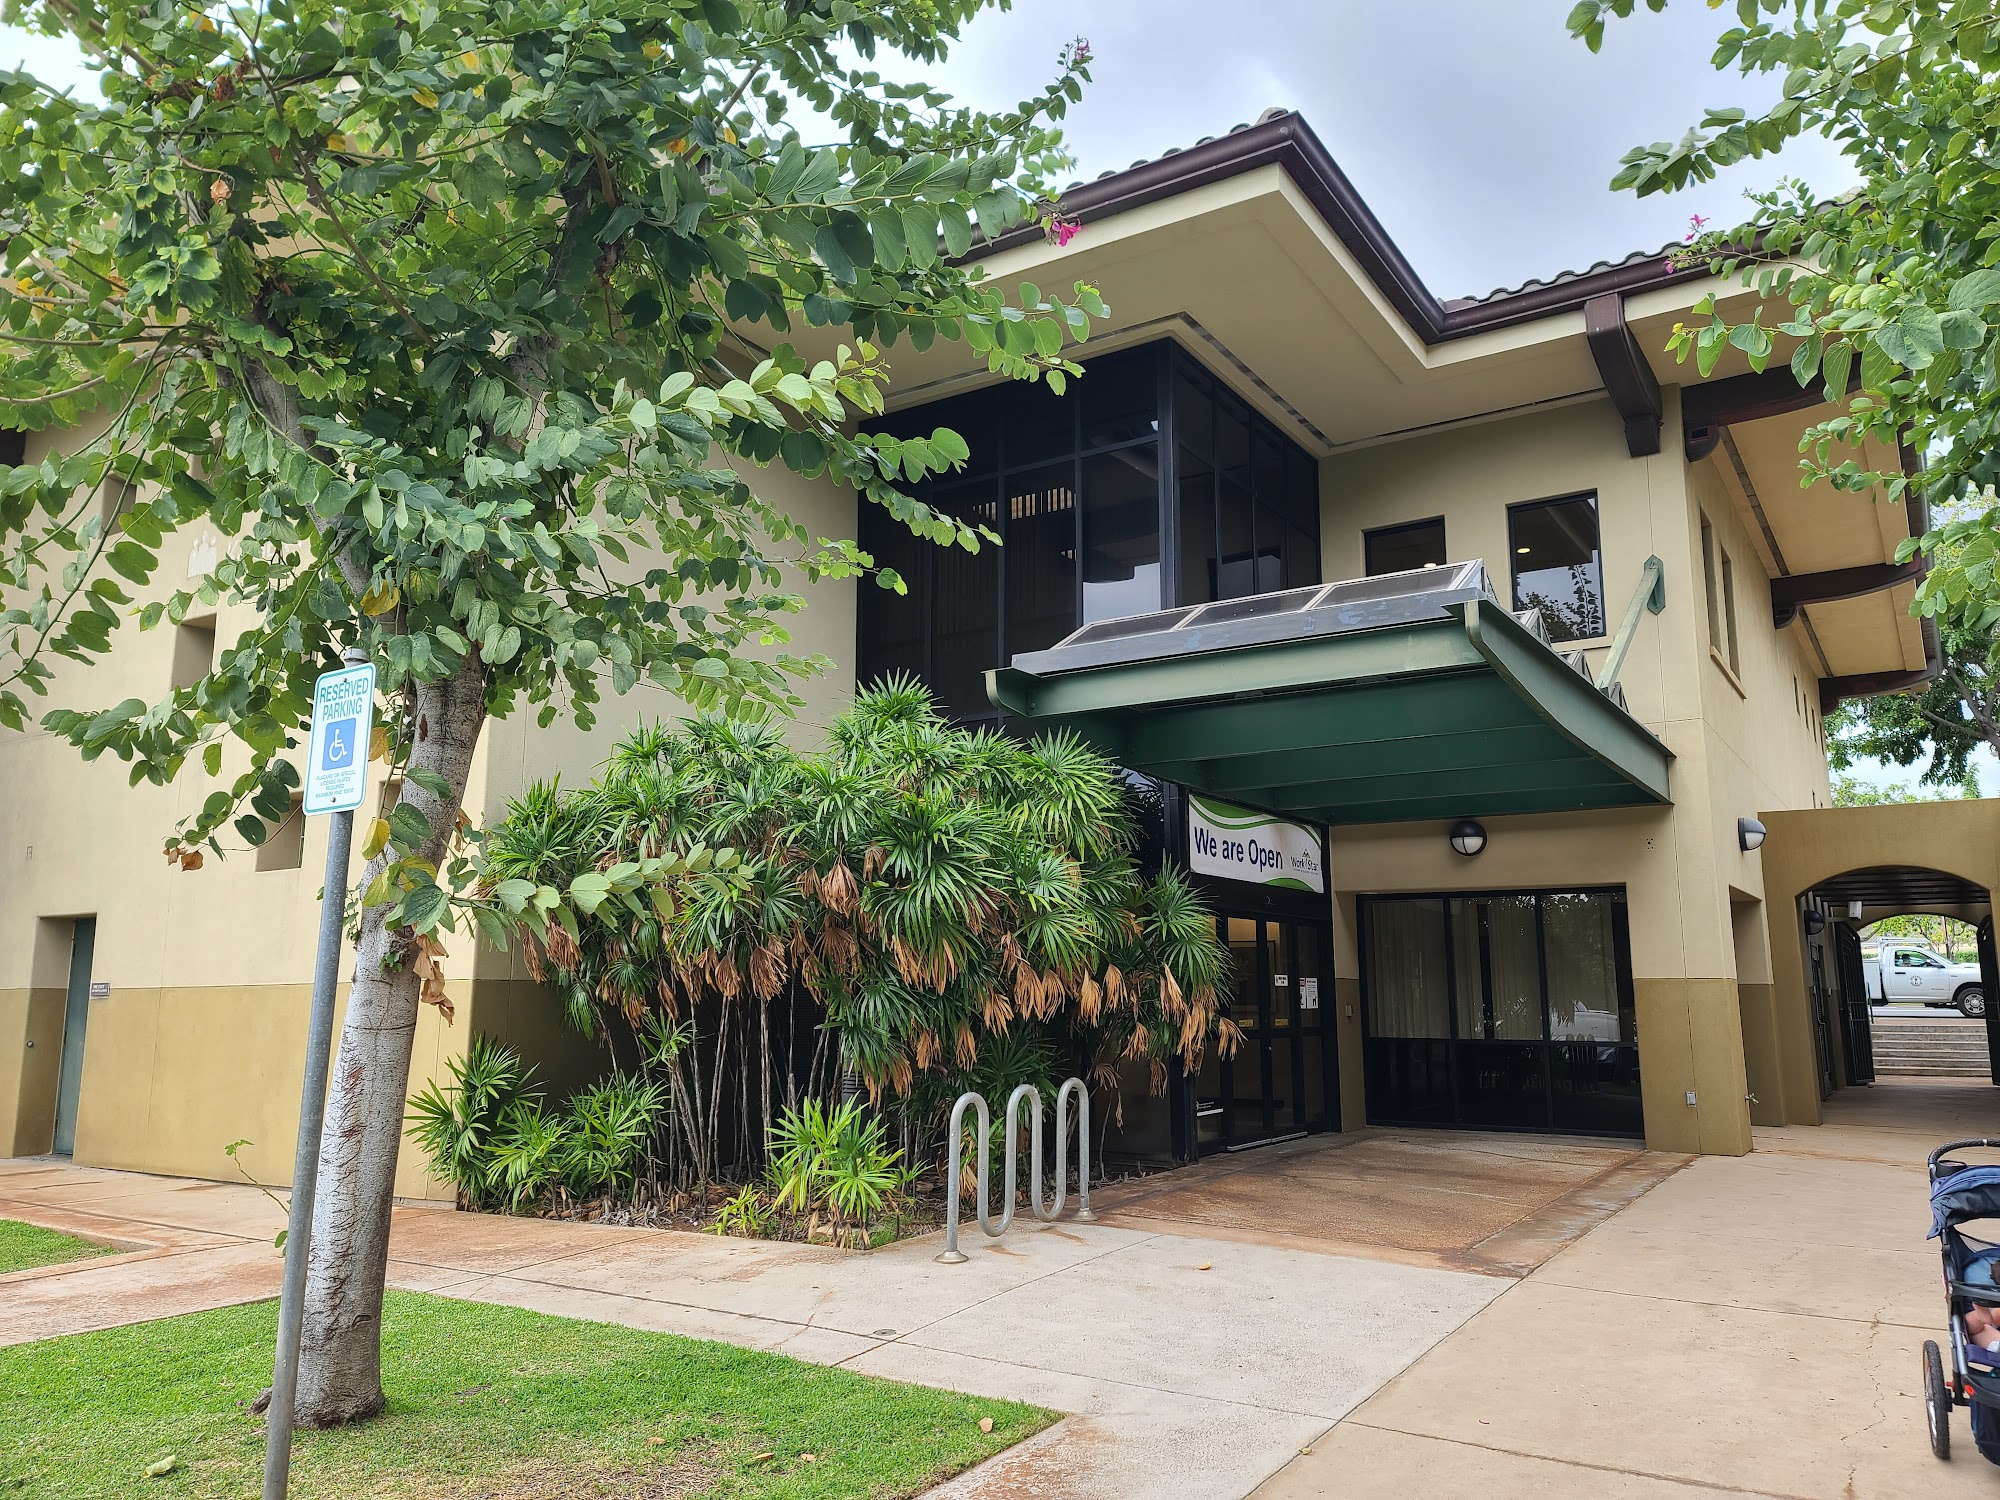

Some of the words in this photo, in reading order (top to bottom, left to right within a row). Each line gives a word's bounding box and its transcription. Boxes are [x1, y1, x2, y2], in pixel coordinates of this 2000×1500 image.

[319, 677, 369, 704] RESERVED
[322, 696, 363, 722] PARKING
[1194, 826, 1217, 857] We
[1222, 839, 1244, 863] are
[1248, 838, 1283, 873] Open
